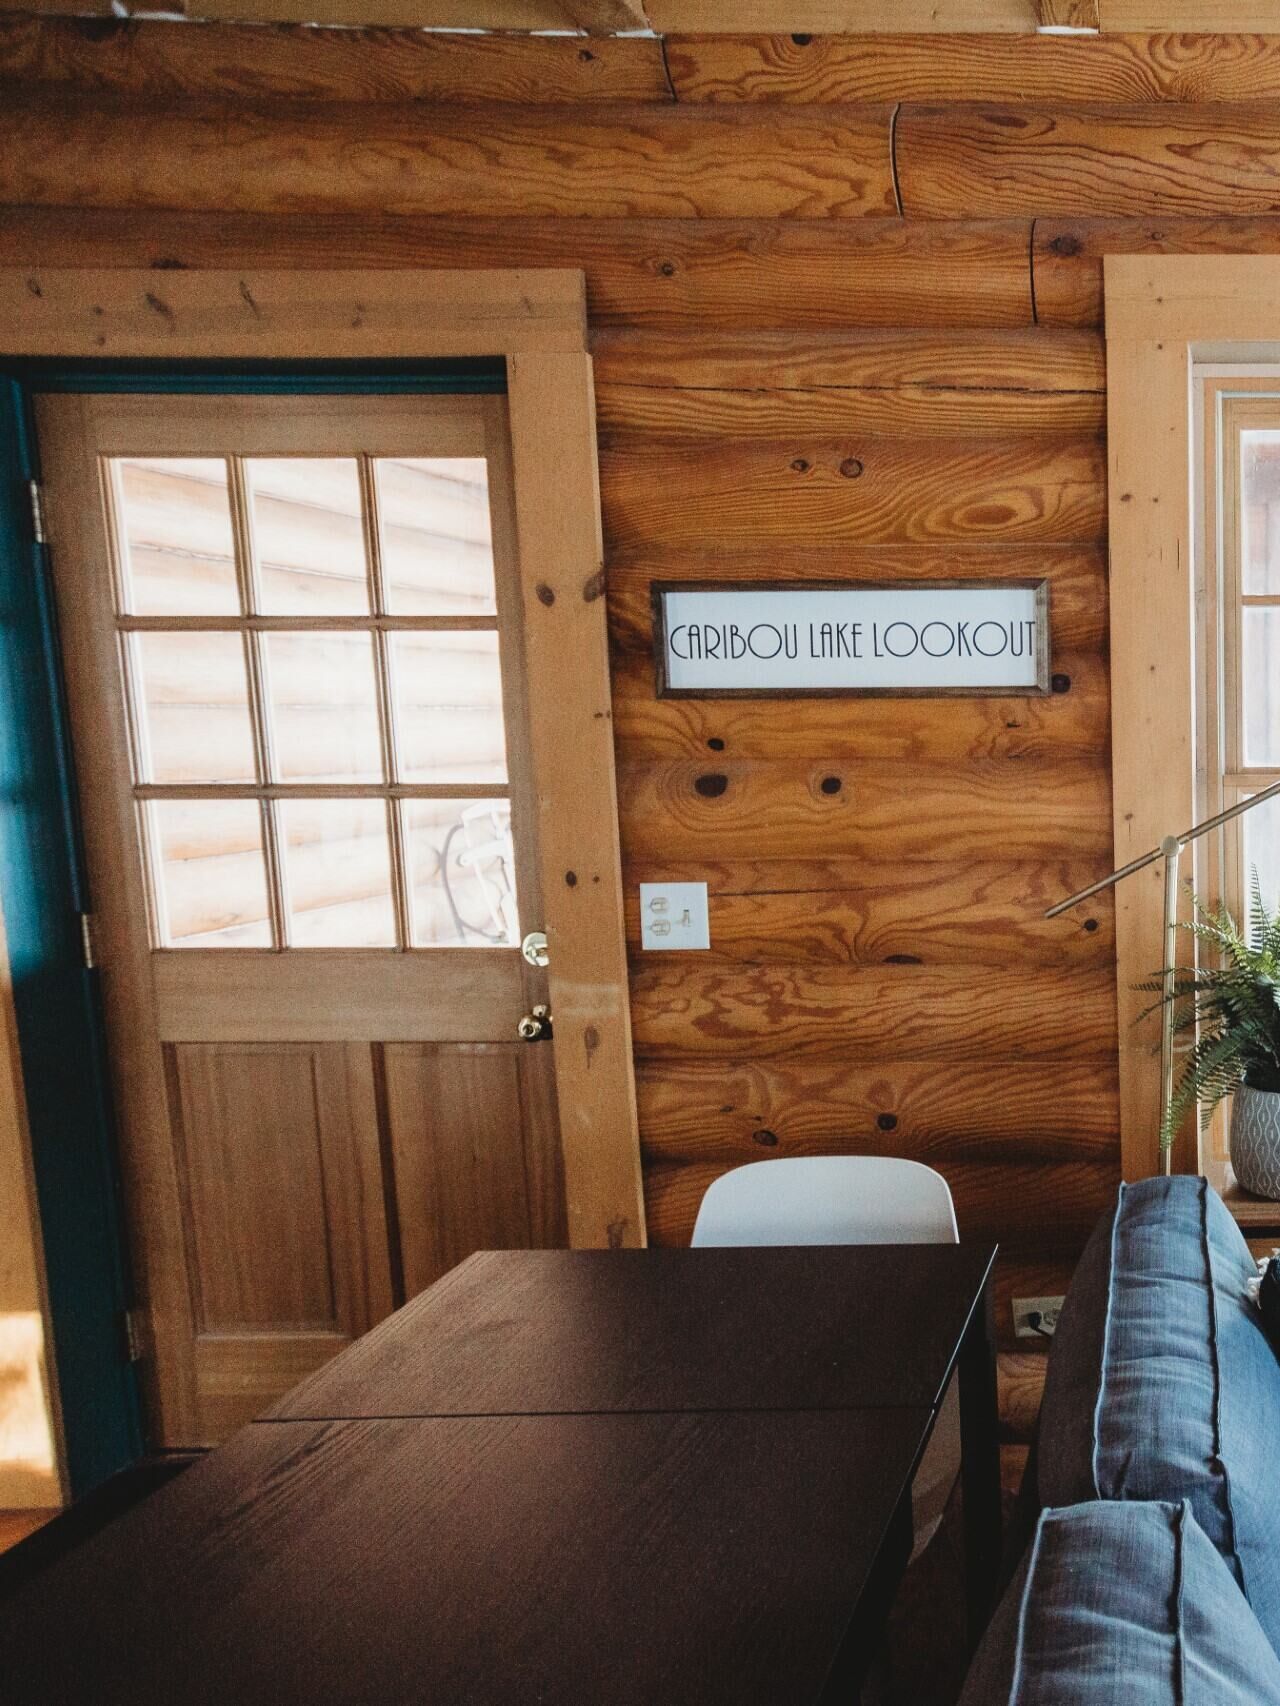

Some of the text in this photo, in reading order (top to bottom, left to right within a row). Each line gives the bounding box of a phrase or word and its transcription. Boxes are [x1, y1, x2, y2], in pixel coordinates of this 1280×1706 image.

[669, 621, 1036, 659] CARIBOU LAKE LOOKOUT
